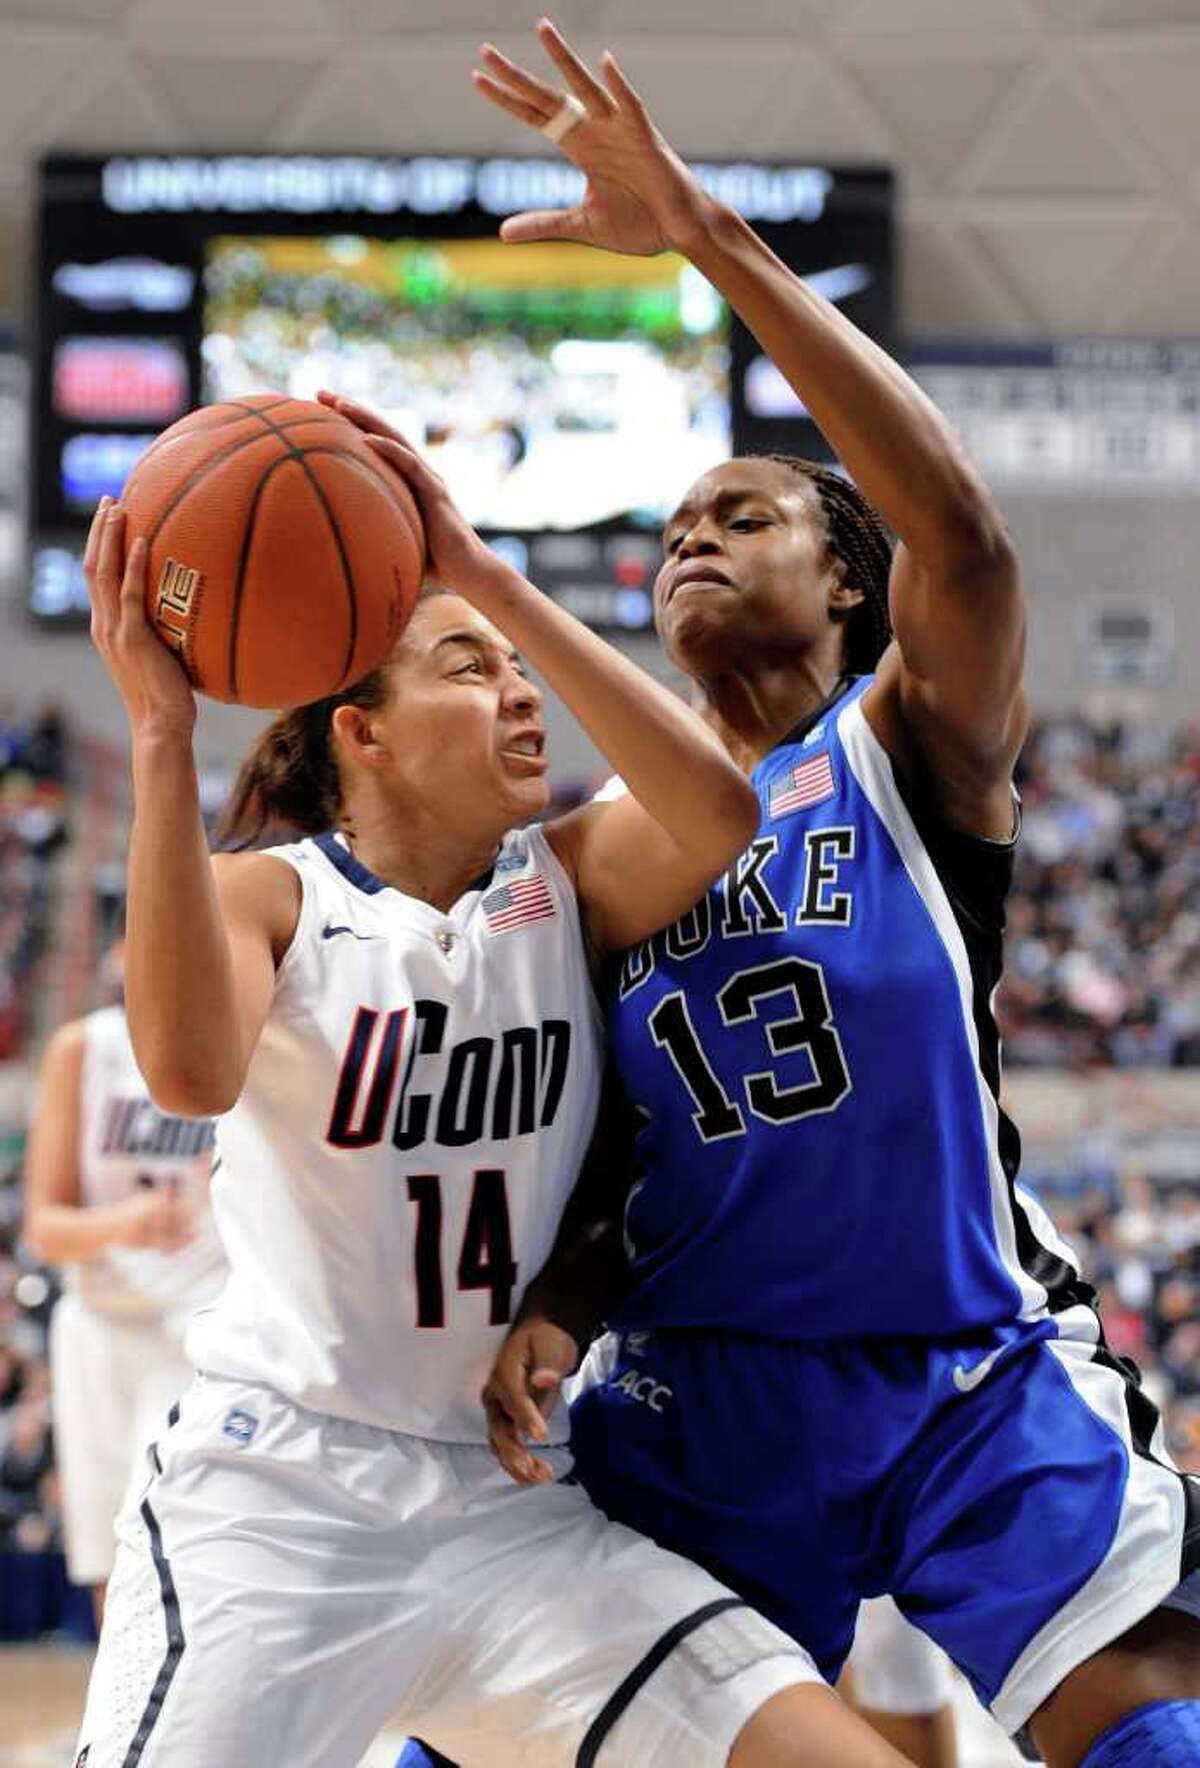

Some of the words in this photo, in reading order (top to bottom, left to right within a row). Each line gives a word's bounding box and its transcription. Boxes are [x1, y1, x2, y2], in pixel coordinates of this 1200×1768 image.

[326, 999, 571, 1151] UConn
[647, 956, 853, 1143] 13
[406, 1169, 517, 1328] 14
[610, 1369, 673, 1412] ACC
